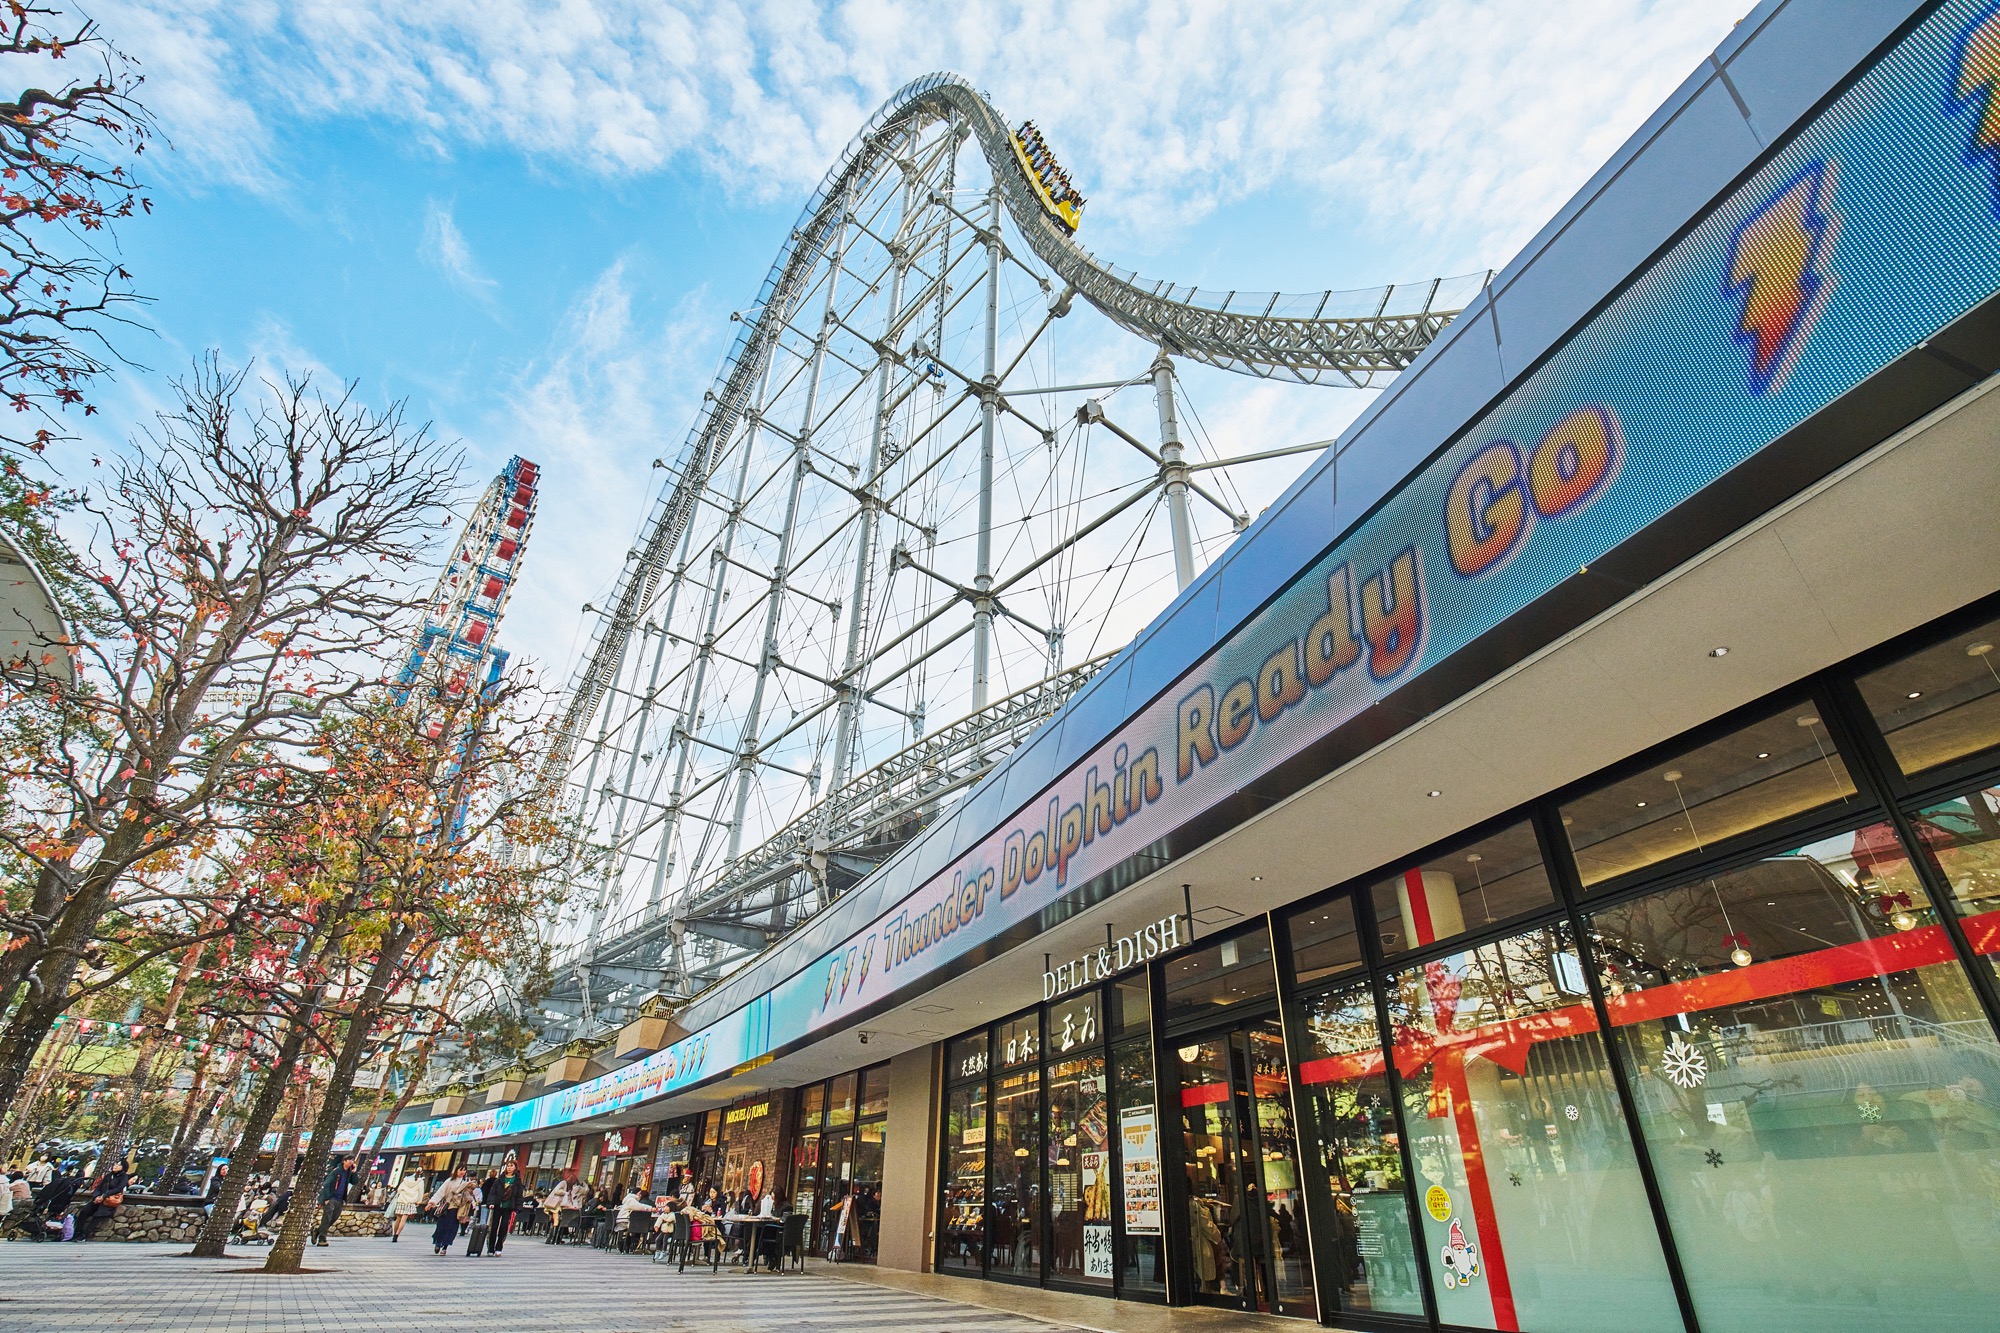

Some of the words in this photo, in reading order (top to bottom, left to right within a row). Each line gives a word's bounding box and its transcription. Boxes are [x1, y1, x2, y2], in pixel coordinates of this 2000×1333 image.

[884, 866, 995, 972] Thunder
[1000, 742, 1163, 899] Dolphin
[1176, 543, 1424, 783] Ready
[1445, 404, 1620, 580] Go
[1042, 954, 1091, 1001] DELI
[1095, 946, 1113, 980] &
[1117, 914, 1179, 970] DISH
[965, 1130, 984, 1141] TEMPURA
